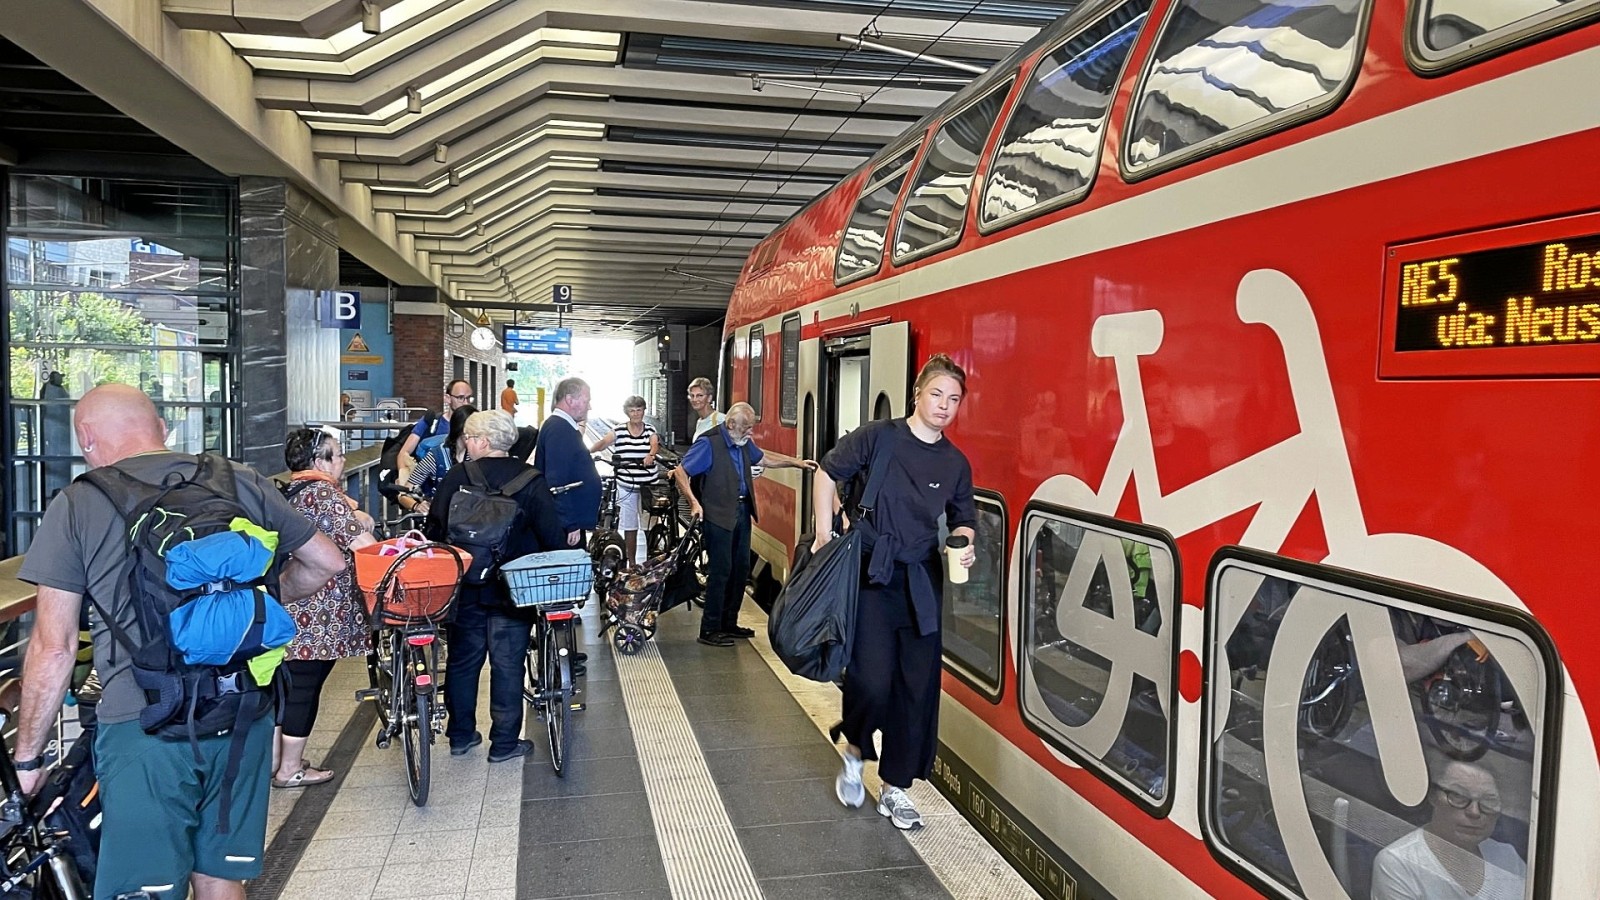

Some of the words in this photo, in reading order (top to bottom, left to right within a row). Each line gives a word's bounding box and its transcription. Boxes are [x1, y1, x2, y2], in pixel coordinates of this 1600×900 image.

[560, 285, 570, 300] 9
[1402, 258, 1459, 305] RE5
[335, 292, 356, 320] B
[1437, 302, 1495, 346] via:
[1505, 296, 1600, 343] Neus
[972, 791, 985, 818] 160
[990, 809, 1000, 833] DB
